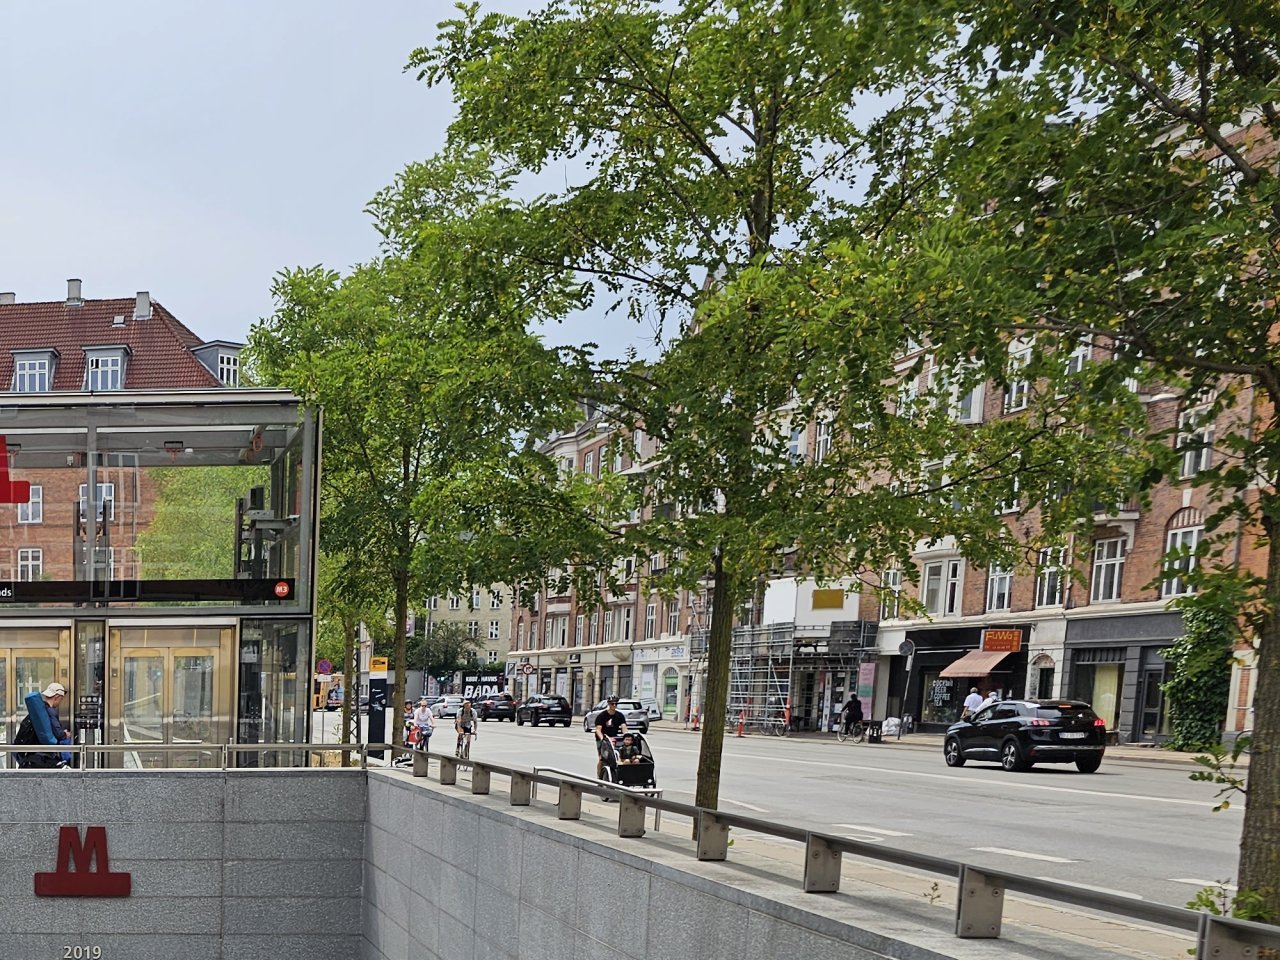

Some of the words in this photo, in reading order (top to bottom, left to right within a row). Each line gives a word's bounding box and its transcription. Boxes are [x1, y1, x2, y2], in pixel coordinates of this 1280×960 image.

[275, 585, 288, 593] M3
[985, 631, 1012, 640] FuWa
[63, 945, 102, 960] 2019
